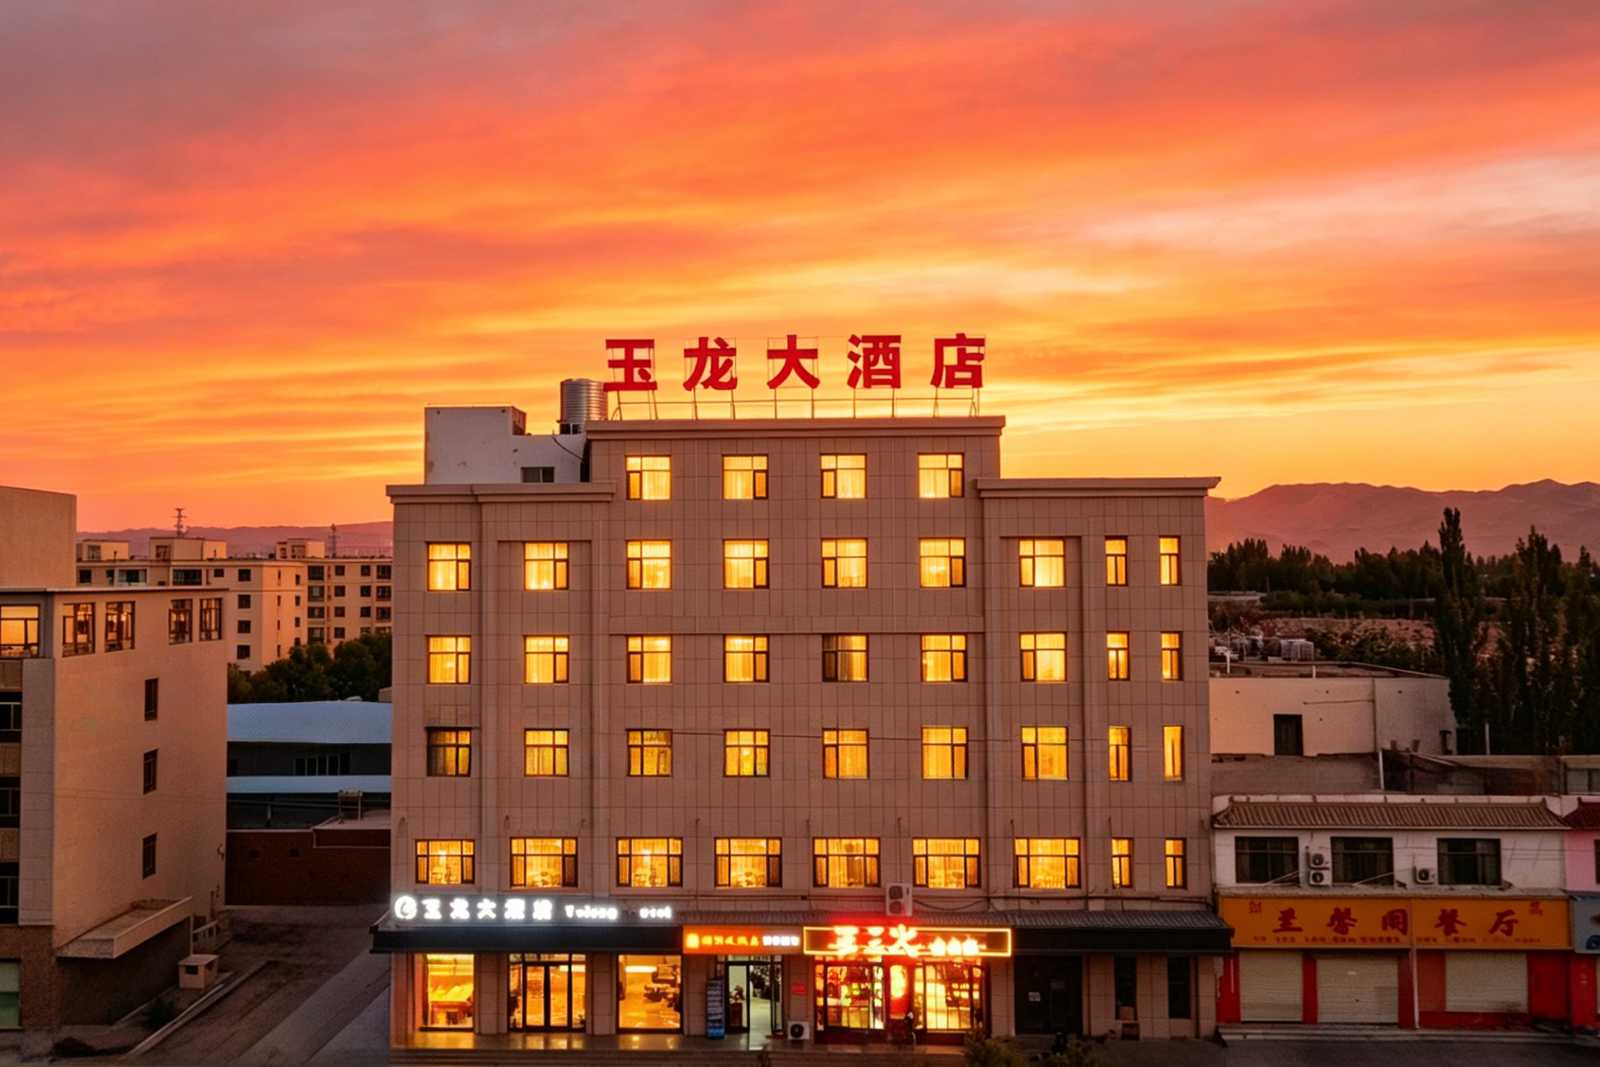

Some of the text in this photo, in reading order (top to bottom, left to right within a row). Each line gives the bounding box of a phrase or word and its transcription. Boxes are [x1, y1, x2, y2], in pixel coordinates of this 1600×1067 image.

[603, 333, 986, 392] 玉龙大酒店
